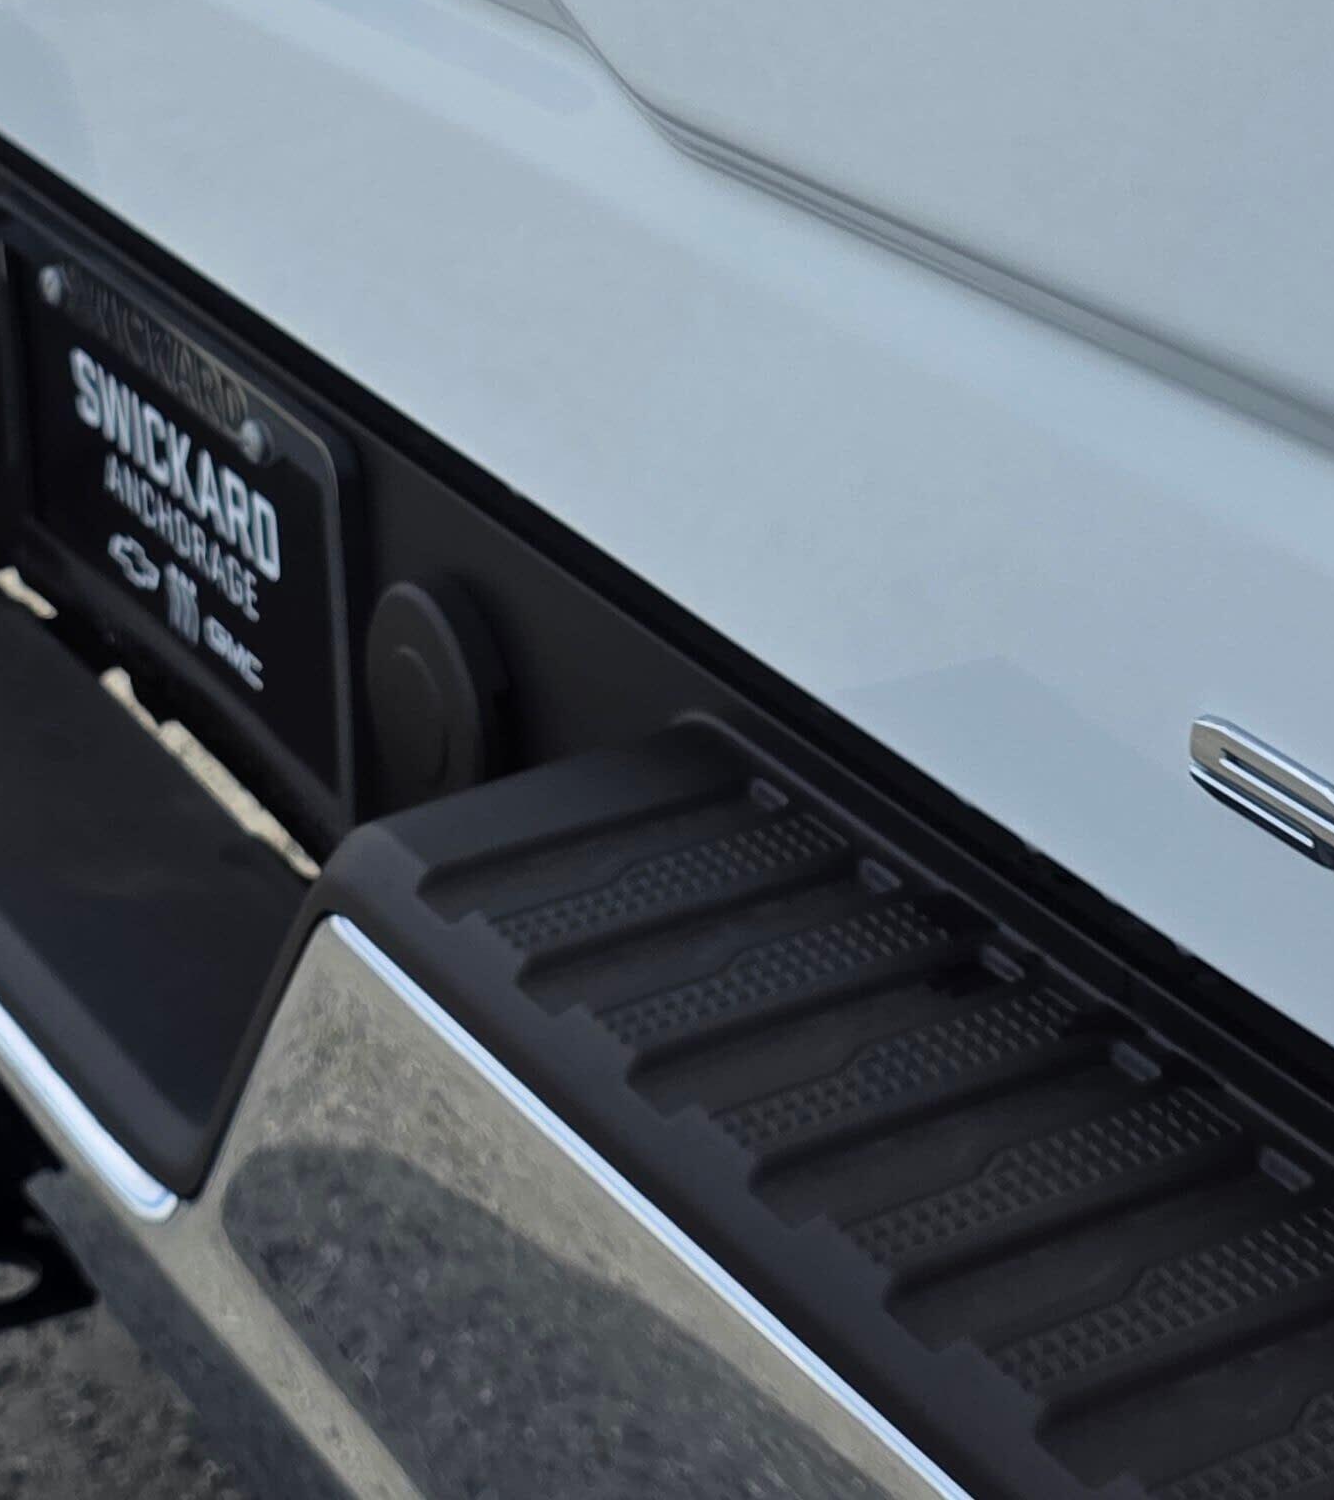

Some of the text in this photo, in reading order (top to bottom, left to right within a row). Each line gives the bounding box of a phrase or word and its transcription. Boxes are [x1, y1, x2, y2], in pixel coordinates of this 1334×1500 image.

[69, 346, 281, 583] SWICKARD
[102, 453, 260, 623] ANCHORAGE
[203, 614, 264, 692] GMC
